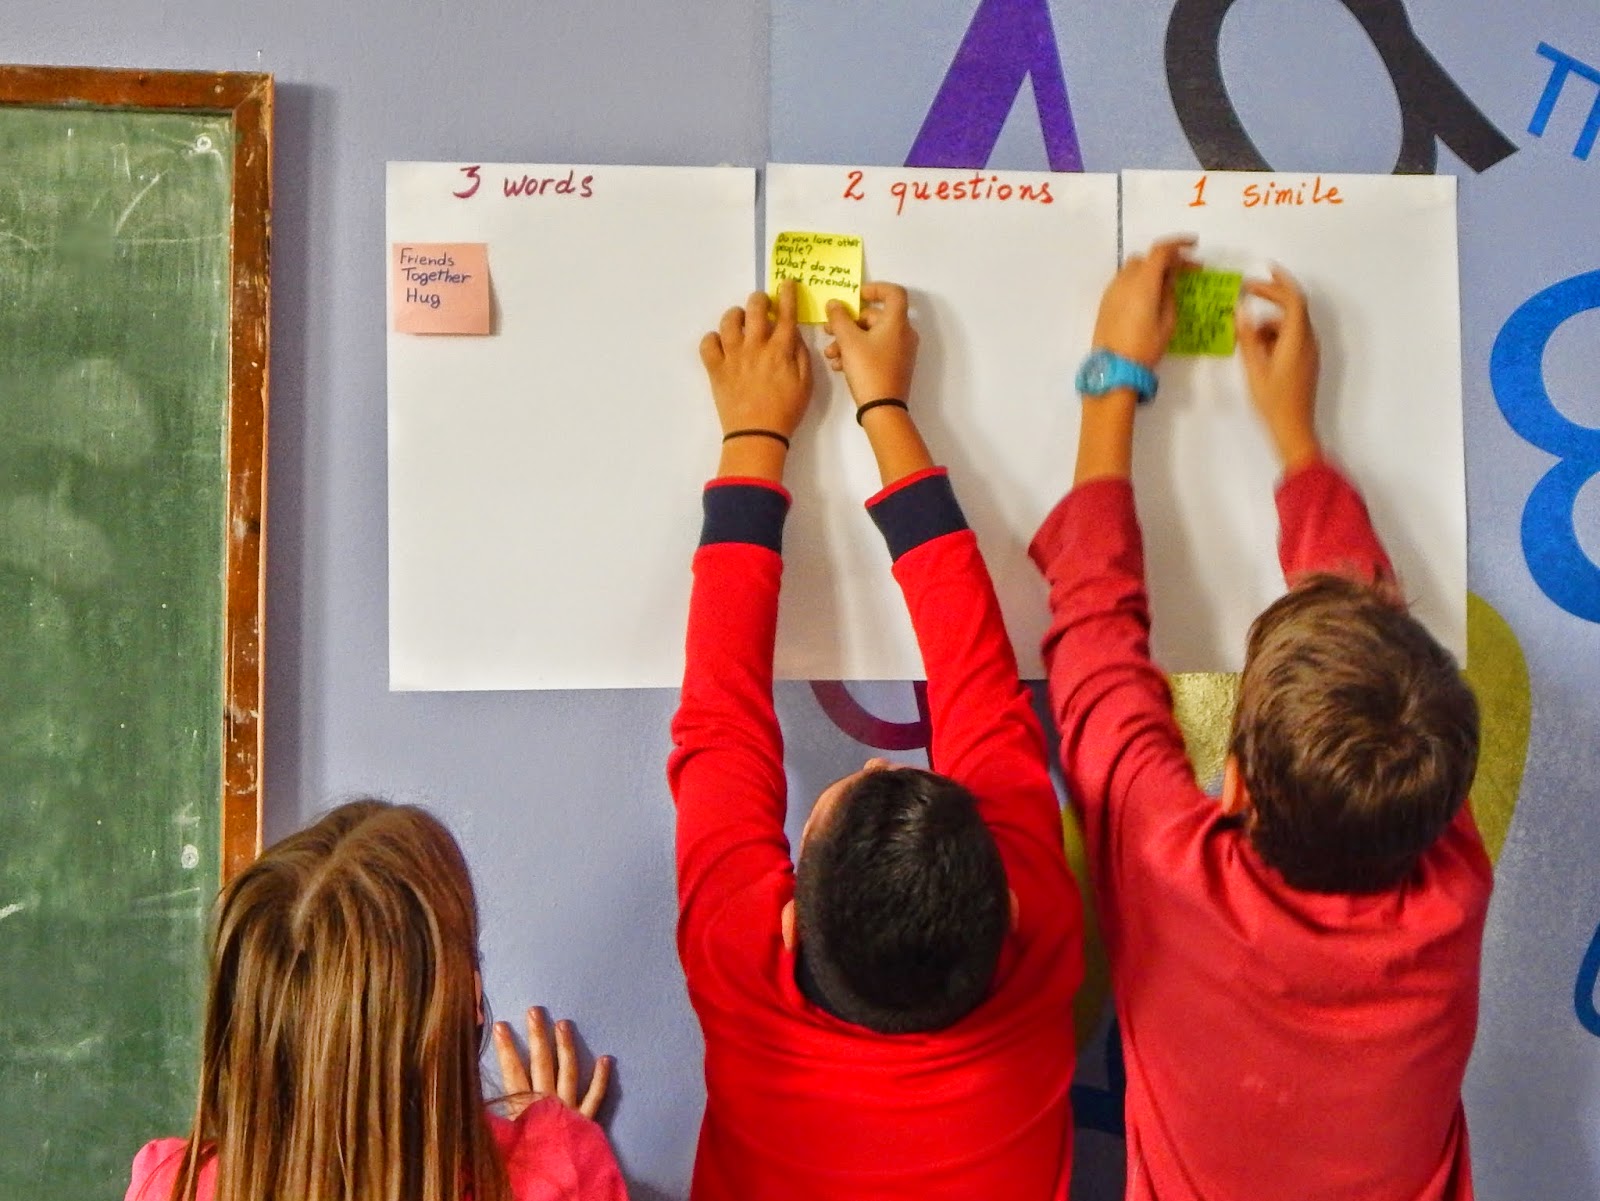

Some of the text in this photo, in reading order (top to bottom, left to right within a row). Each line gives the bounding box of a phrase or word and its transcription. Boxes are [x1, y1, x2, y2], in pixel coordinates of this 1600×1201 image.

[452, 165, 594, 199] 3 words
[1188, 175, 1344, 208] 1 simile
[843, 170, 1054, 216] 2 questions
[778, 232, 861, 247] Do you love other
[400, 247, 455, 267] Friends
[775, 243, 813, 259] people?
[401, 266, 472, 286] Together
[810, 260, 826, 272] do
[829, 265, 851, 276] you
[406, 287, 441, 309] Hug
